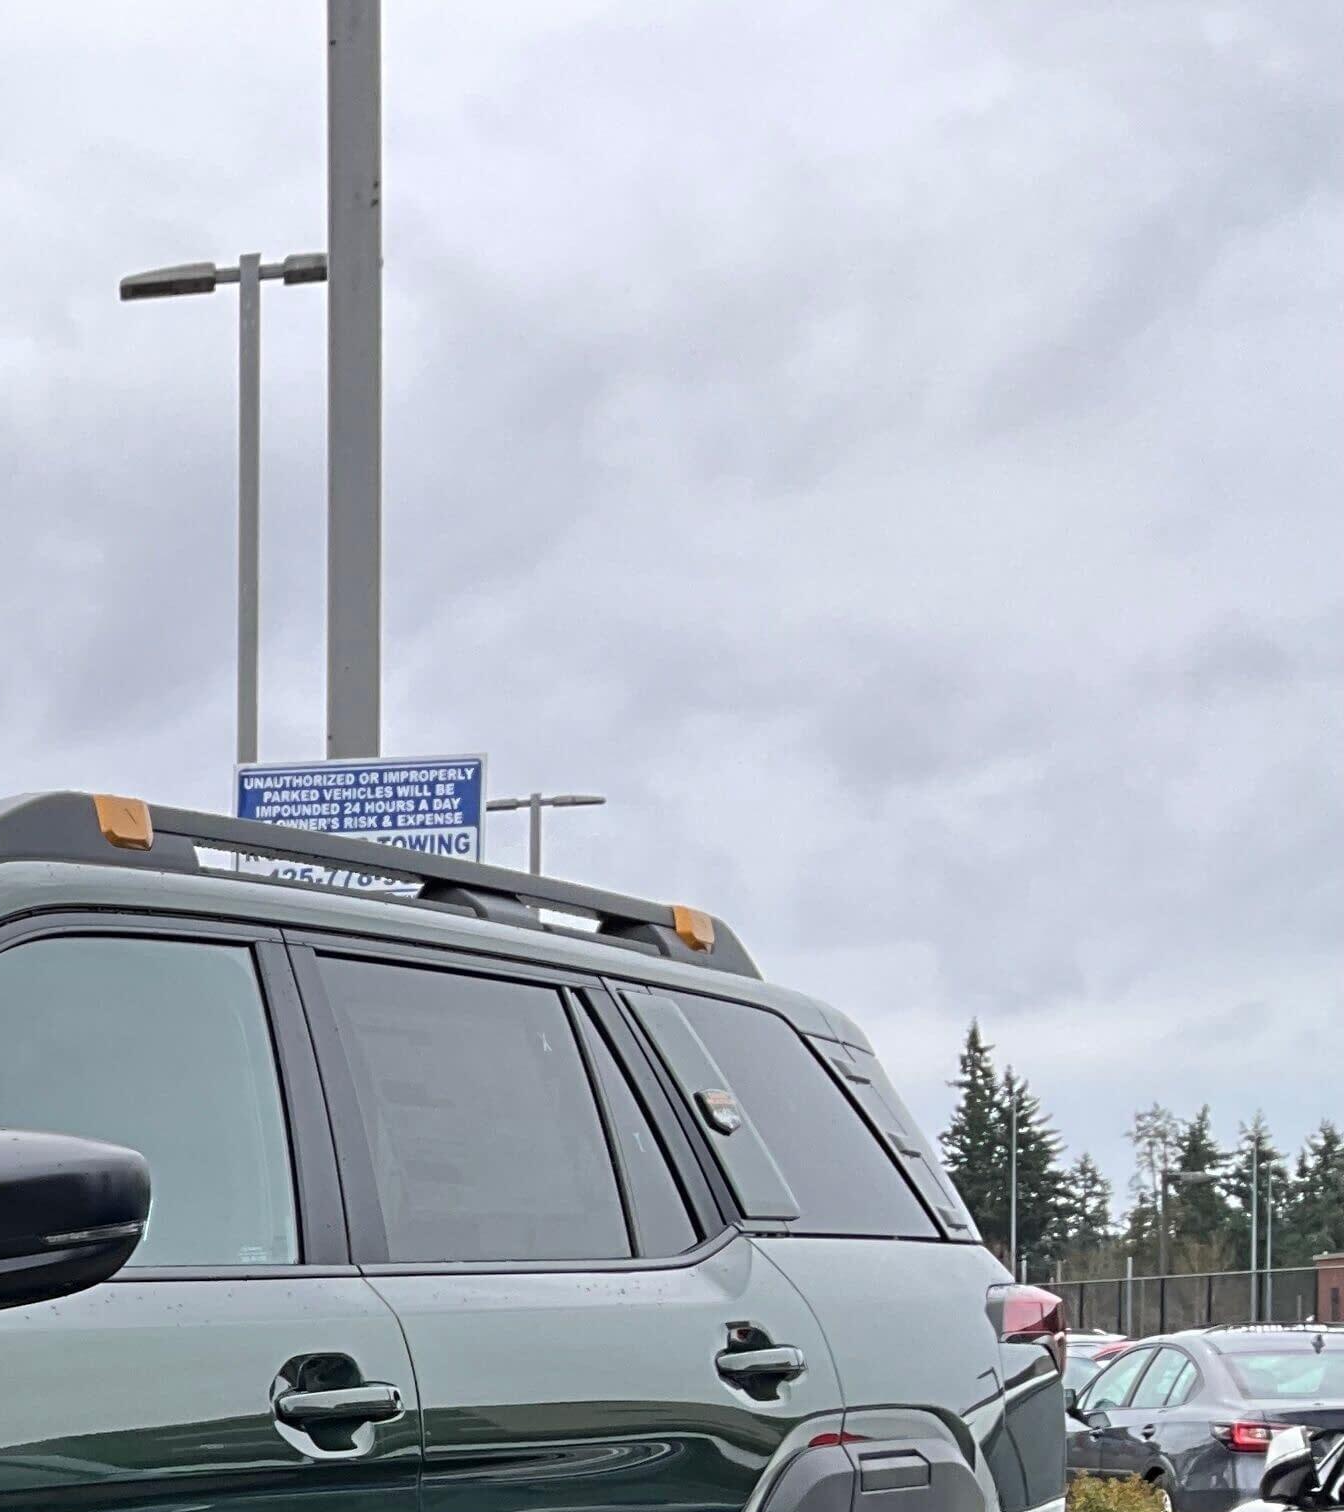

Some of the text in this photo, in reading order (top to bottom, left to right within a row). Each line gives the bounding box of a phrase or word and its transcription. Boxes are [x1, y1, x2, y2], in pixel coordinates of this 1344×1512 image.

[243, 767, 475, 790] UNAUTHORIZED OR IMPROPERLY
[262, 783, 455, 803] PARKED VEHICLES WILL BE
[255, 797, 462, 818] IMPOUNDED 24 HOURS A DAY
[343, 814, 379, 829] RISK
[381, 814, 393, 828] &
[396, 811, 464, 827] EXPENSE
